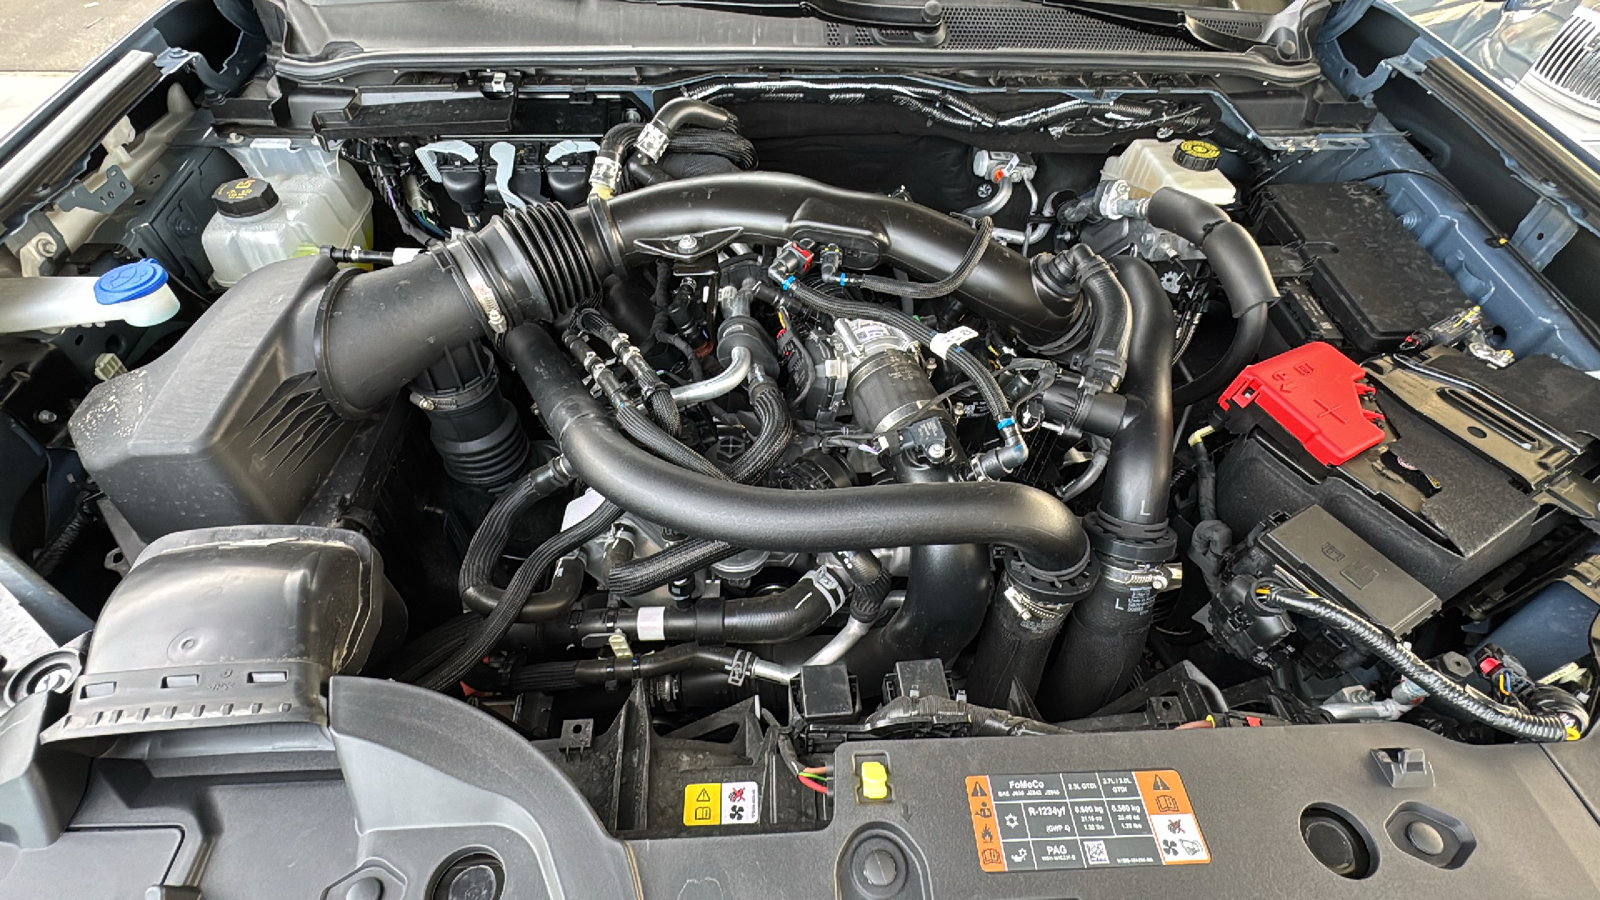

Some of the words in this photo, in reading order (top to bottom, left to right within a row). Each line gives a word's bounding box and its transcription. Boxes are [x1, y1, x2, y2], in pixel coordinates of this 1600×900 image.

[1140, 499, 1151, 516] L
[1114, 598, 1124, 611] L
[1008, 780, 1045, 789] FoMoCo
[1027, 805, 1066, 818] R-1234yf
[1094, 805, 1104, 814] kg
[1130, 804, 1141, 813] kg
[1046, 844, 1068, 855] PAG
